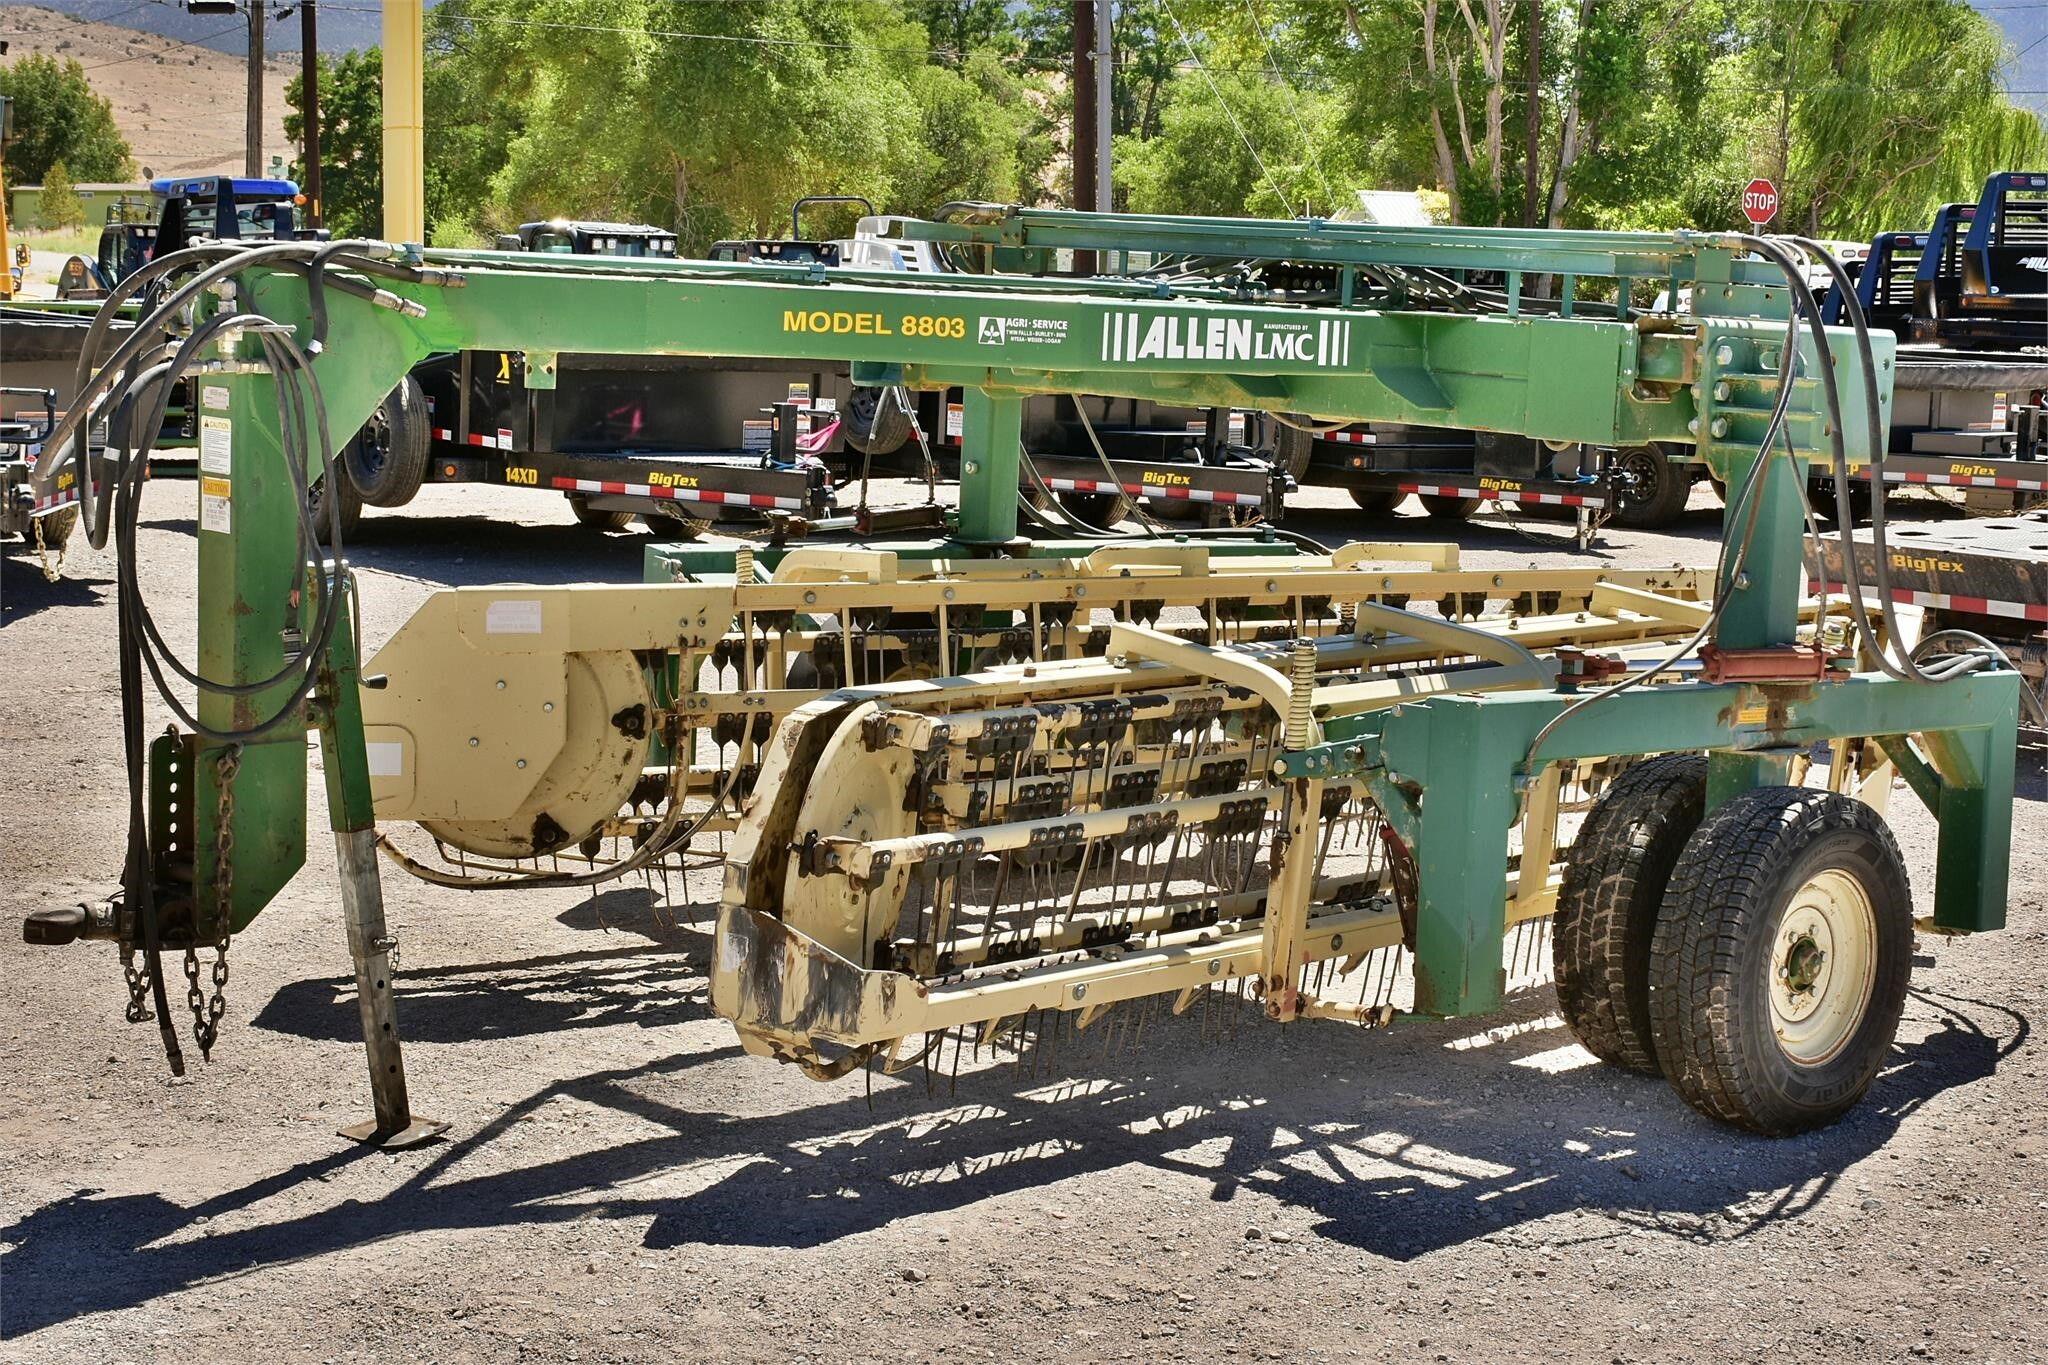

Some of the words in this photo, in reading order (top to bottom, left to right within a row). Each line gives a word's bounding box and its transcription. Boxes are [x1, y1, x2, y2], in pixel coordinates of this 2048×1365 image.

[1745, 192, 1775, 210] STOP
[783, 310, 893, 336] MODEL
[900, 315, 967, 339] 8803
[1263, 323, 1302, 331] MANUFACTURED
[1137, 316, 1252, 360] ALLEN
[1254, 332, 1315, 361] LMC
[504, 466, 538, 485] 14XD
[1142, 471, 1191, 486] BigTex
[1950, 464, 1997, 476] BigTex
[647, 471, 699, 488] BigTex
[1479, 478, 1522, 491] BigTex
[1893, 554, 1965, 573] BigTex
